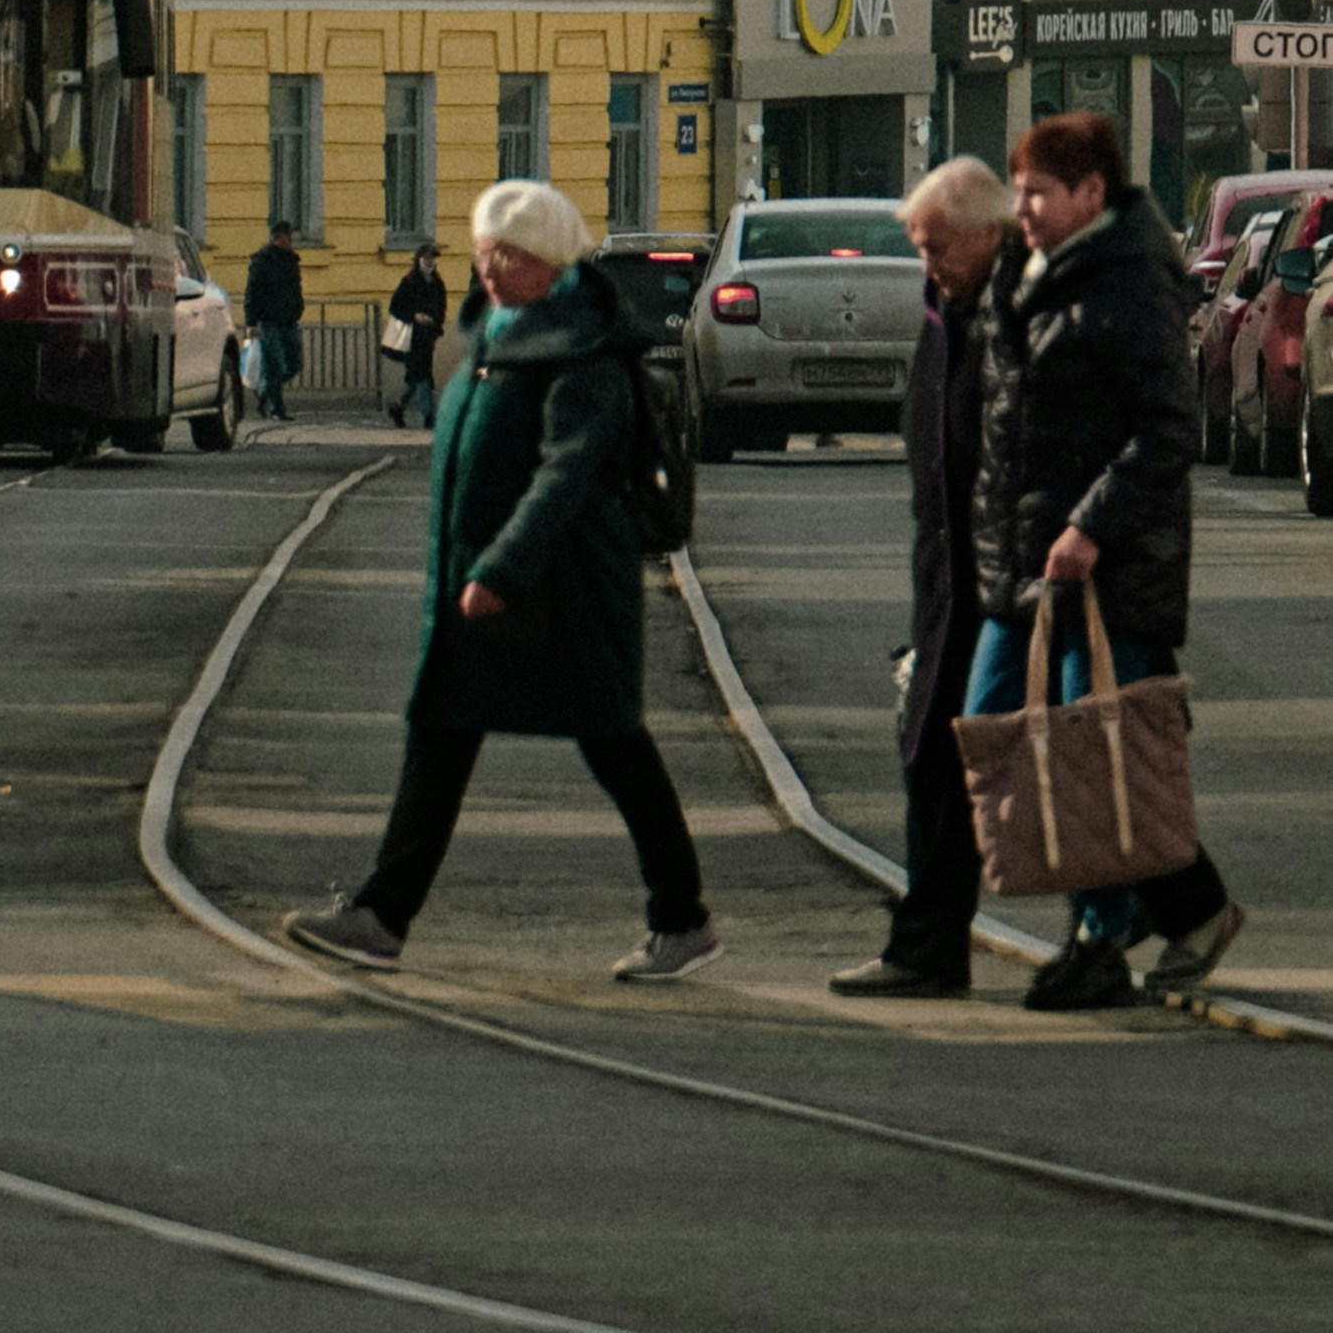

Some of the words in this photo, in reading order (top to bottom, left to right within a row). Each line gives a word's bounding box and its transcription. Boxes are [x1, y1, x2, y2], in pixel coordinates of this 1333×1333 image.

[968, 6, 1014, 42] LEE'S
[1036, 8, 1106, 43] КОРЕЙСКАЯ
[1110, 11, 1148, 40] КУХНЯ
[1161, 9, 1199, 38] ГРИЛЬ
[681, 125, 694, 144] 23
